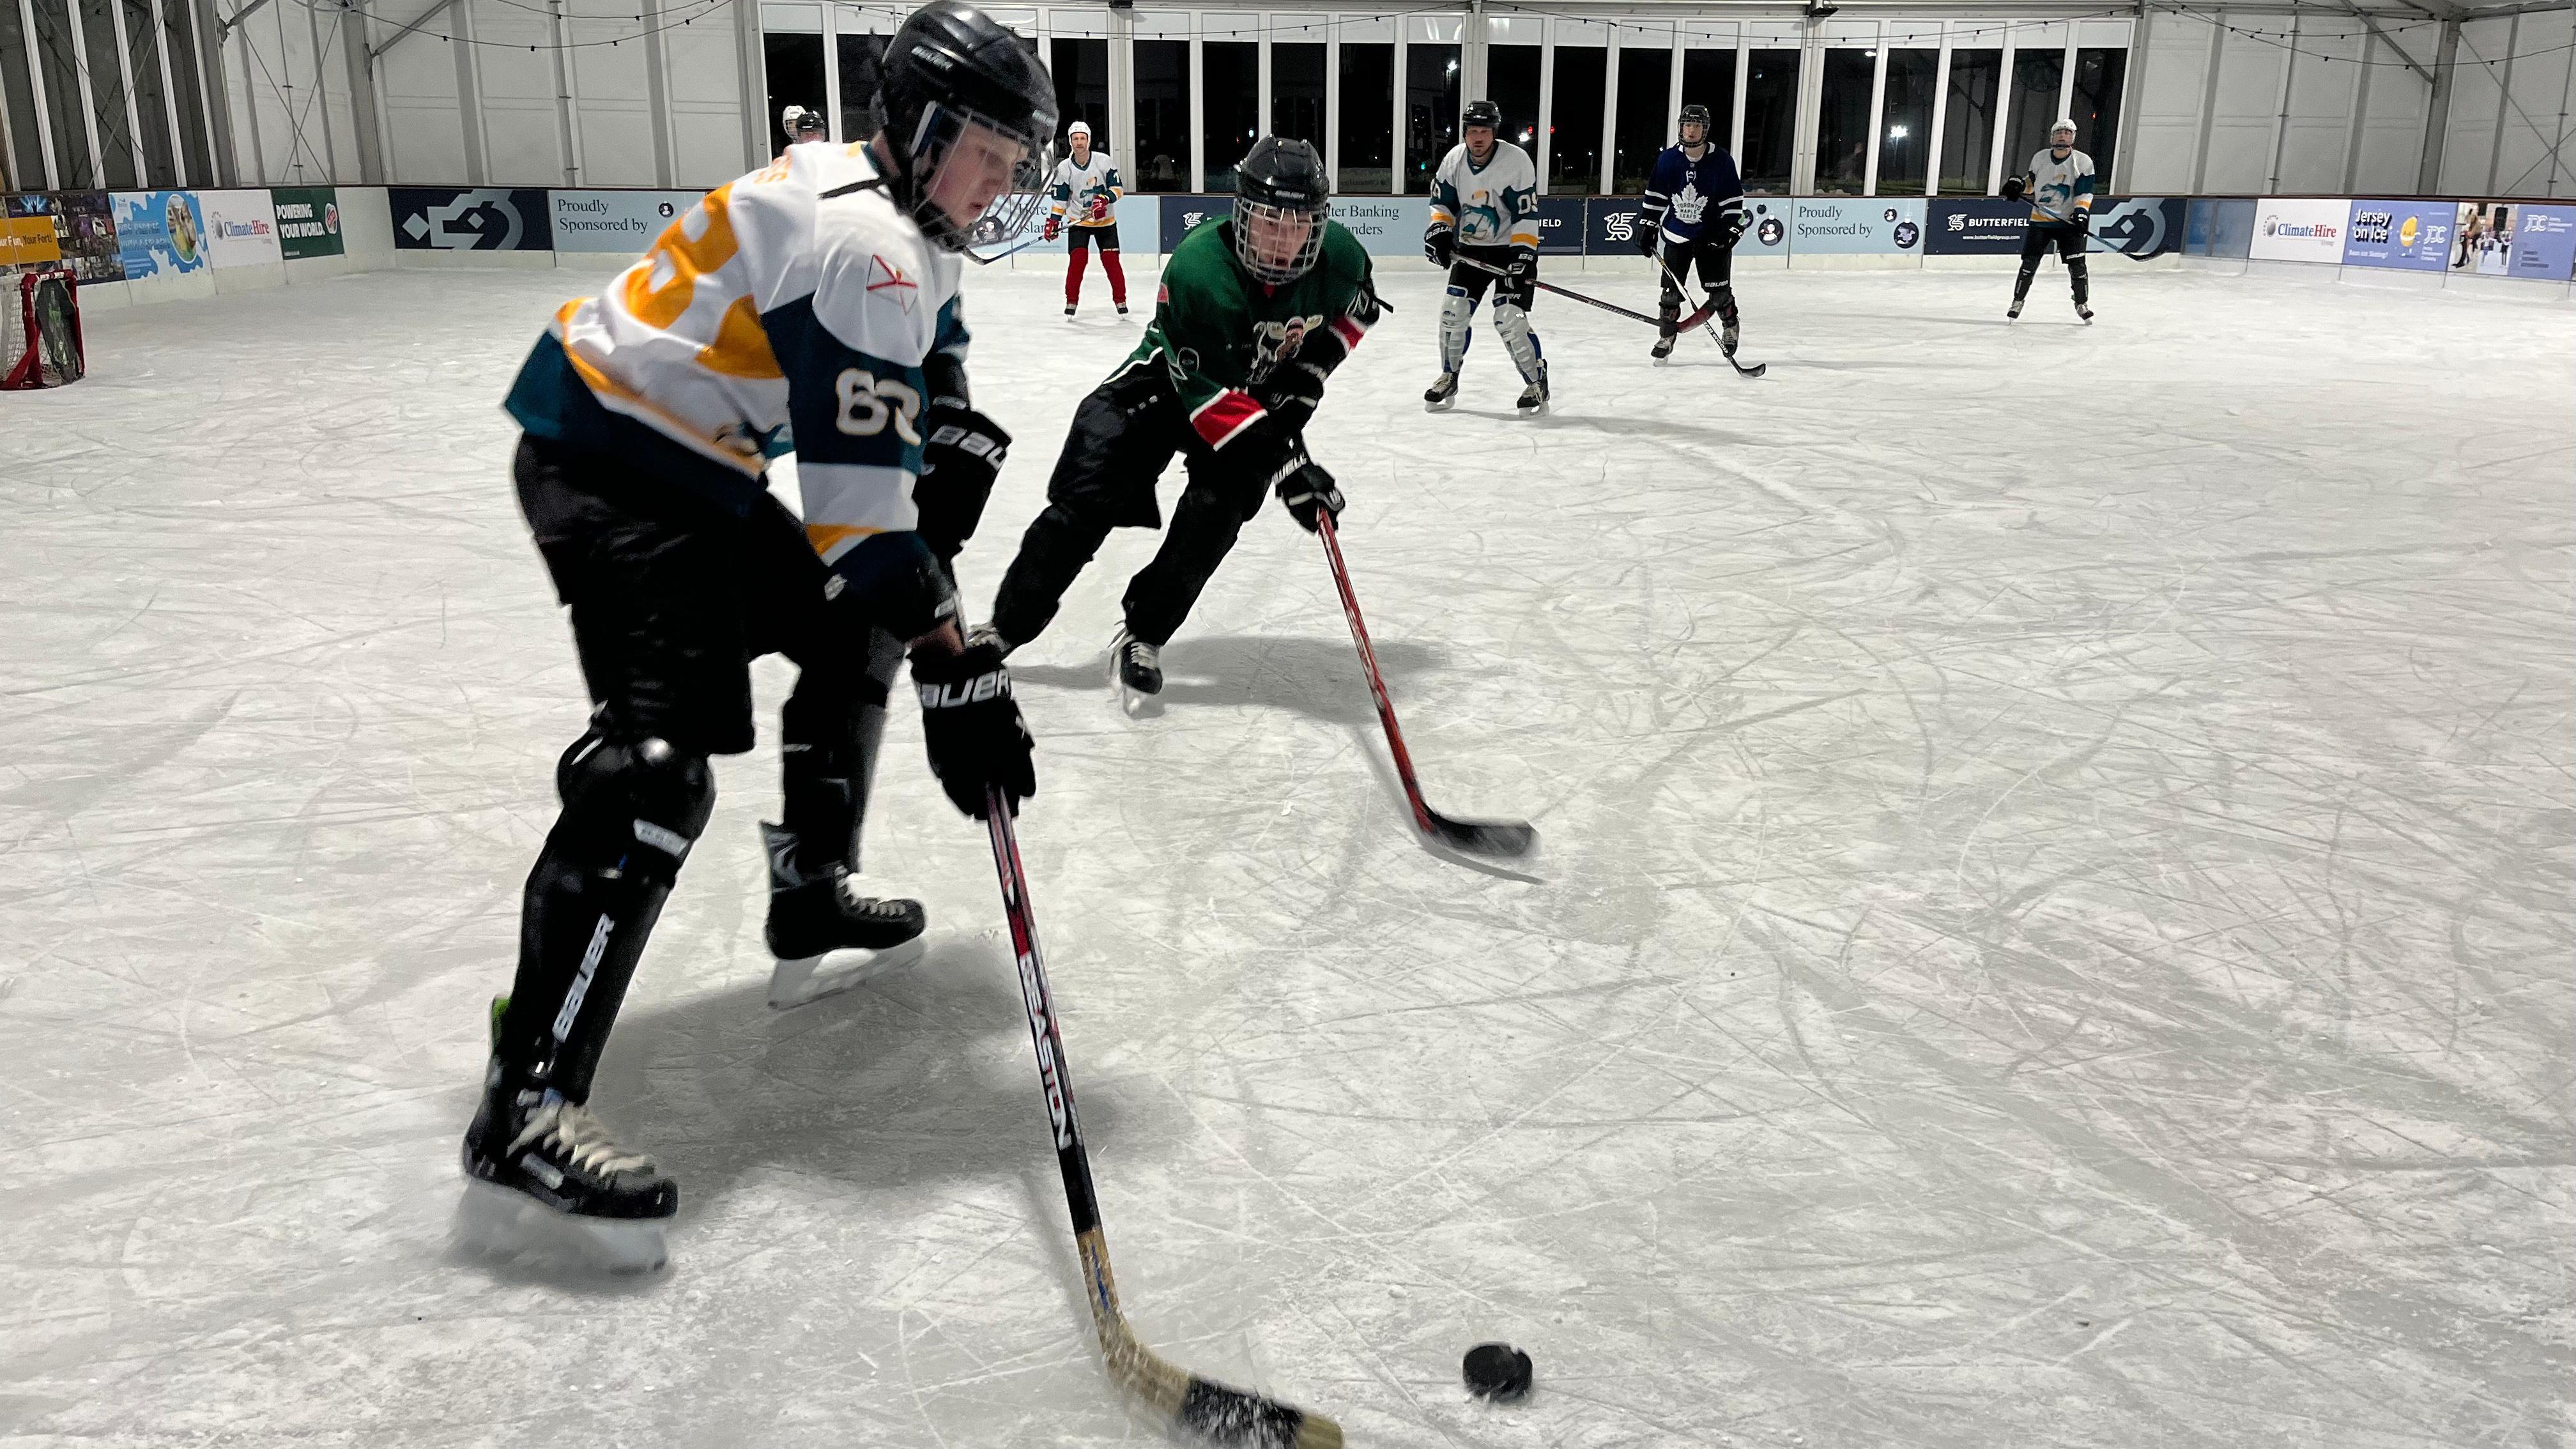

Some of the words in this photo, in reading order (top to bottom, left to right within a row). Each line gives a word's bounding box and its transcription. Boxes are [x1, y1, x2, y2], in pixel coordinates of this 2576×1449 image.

[276, 203, 313, 220] POWERING
[557, 199, 609, 215] Proudly
[1350, 204, 1400, 220] Banking
[1677, 203, 1701, 211] TORONTO
[1798, 205, 1843, 221] Proudly
[559, 217, 628, 234] Sponsored
[632, 218, 648, 234] by
[1968, 218, 2030, 227] BUTTERFIEL
[2355, 208, 2391, 227] Jersey
[224, 219, 270, 237] ClimateHire
[280, 224, 300, 239] YOUR
[300, 222, 325, 237] WORLD.
[1797, 223, 1856, 238] Sponsored
[1859, 223, 1873, 238] by
[2278, 223, 2337, 238] ClimateHire
[2353, 227, 2368, 239] on
[2371, 226, 2388, 240] Ice
[919, 668, 1010, 709] AUER
[552, 912, 615, 1043] BAUER
